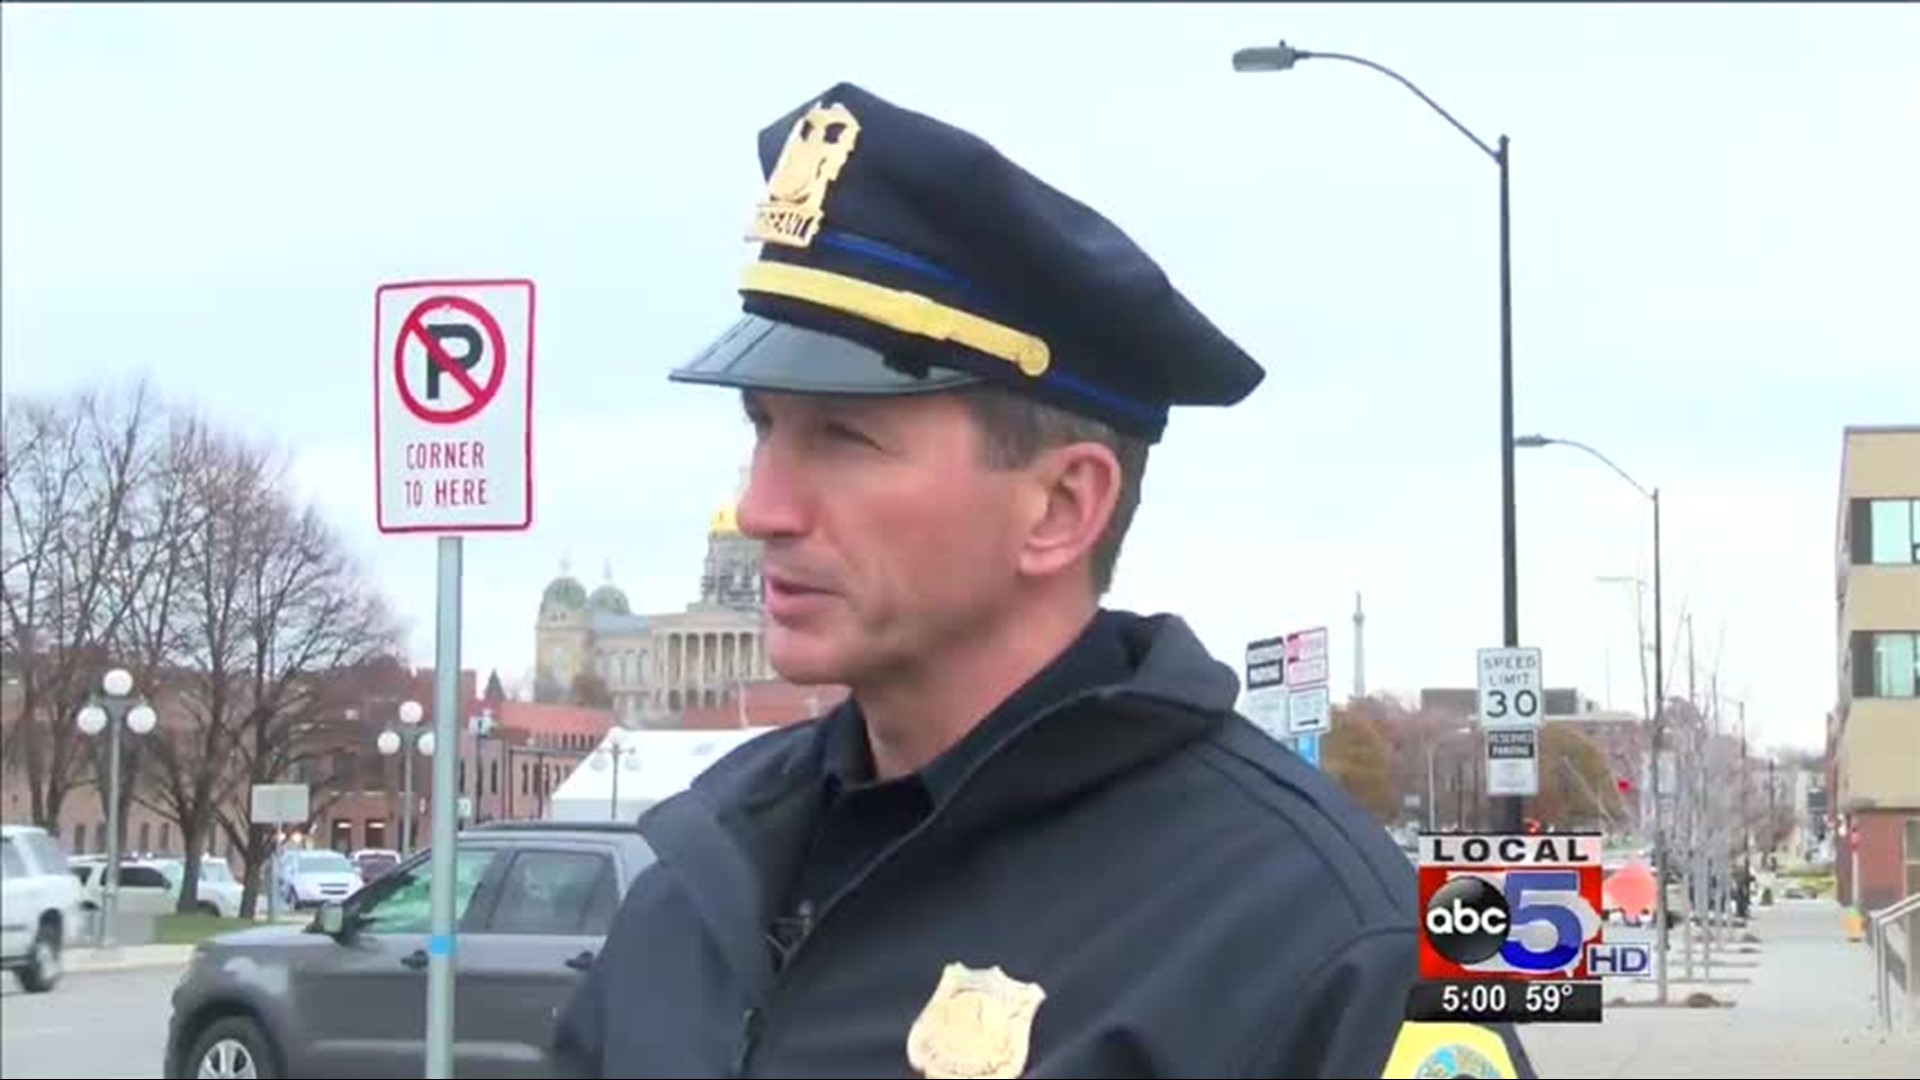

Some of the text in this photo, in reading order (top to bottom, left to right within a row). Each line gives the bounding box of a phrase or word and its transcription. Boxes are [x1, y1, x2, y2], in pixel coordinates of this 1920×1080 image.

[406, 441, 485, 470] CORNER
[405, 478, 488, 507] TO HERE
[1483, 655, 1536, 670] SPEED
[1489, 672, 1530, 686] LIMIT
[1486, 689, 1537, 718] 30
